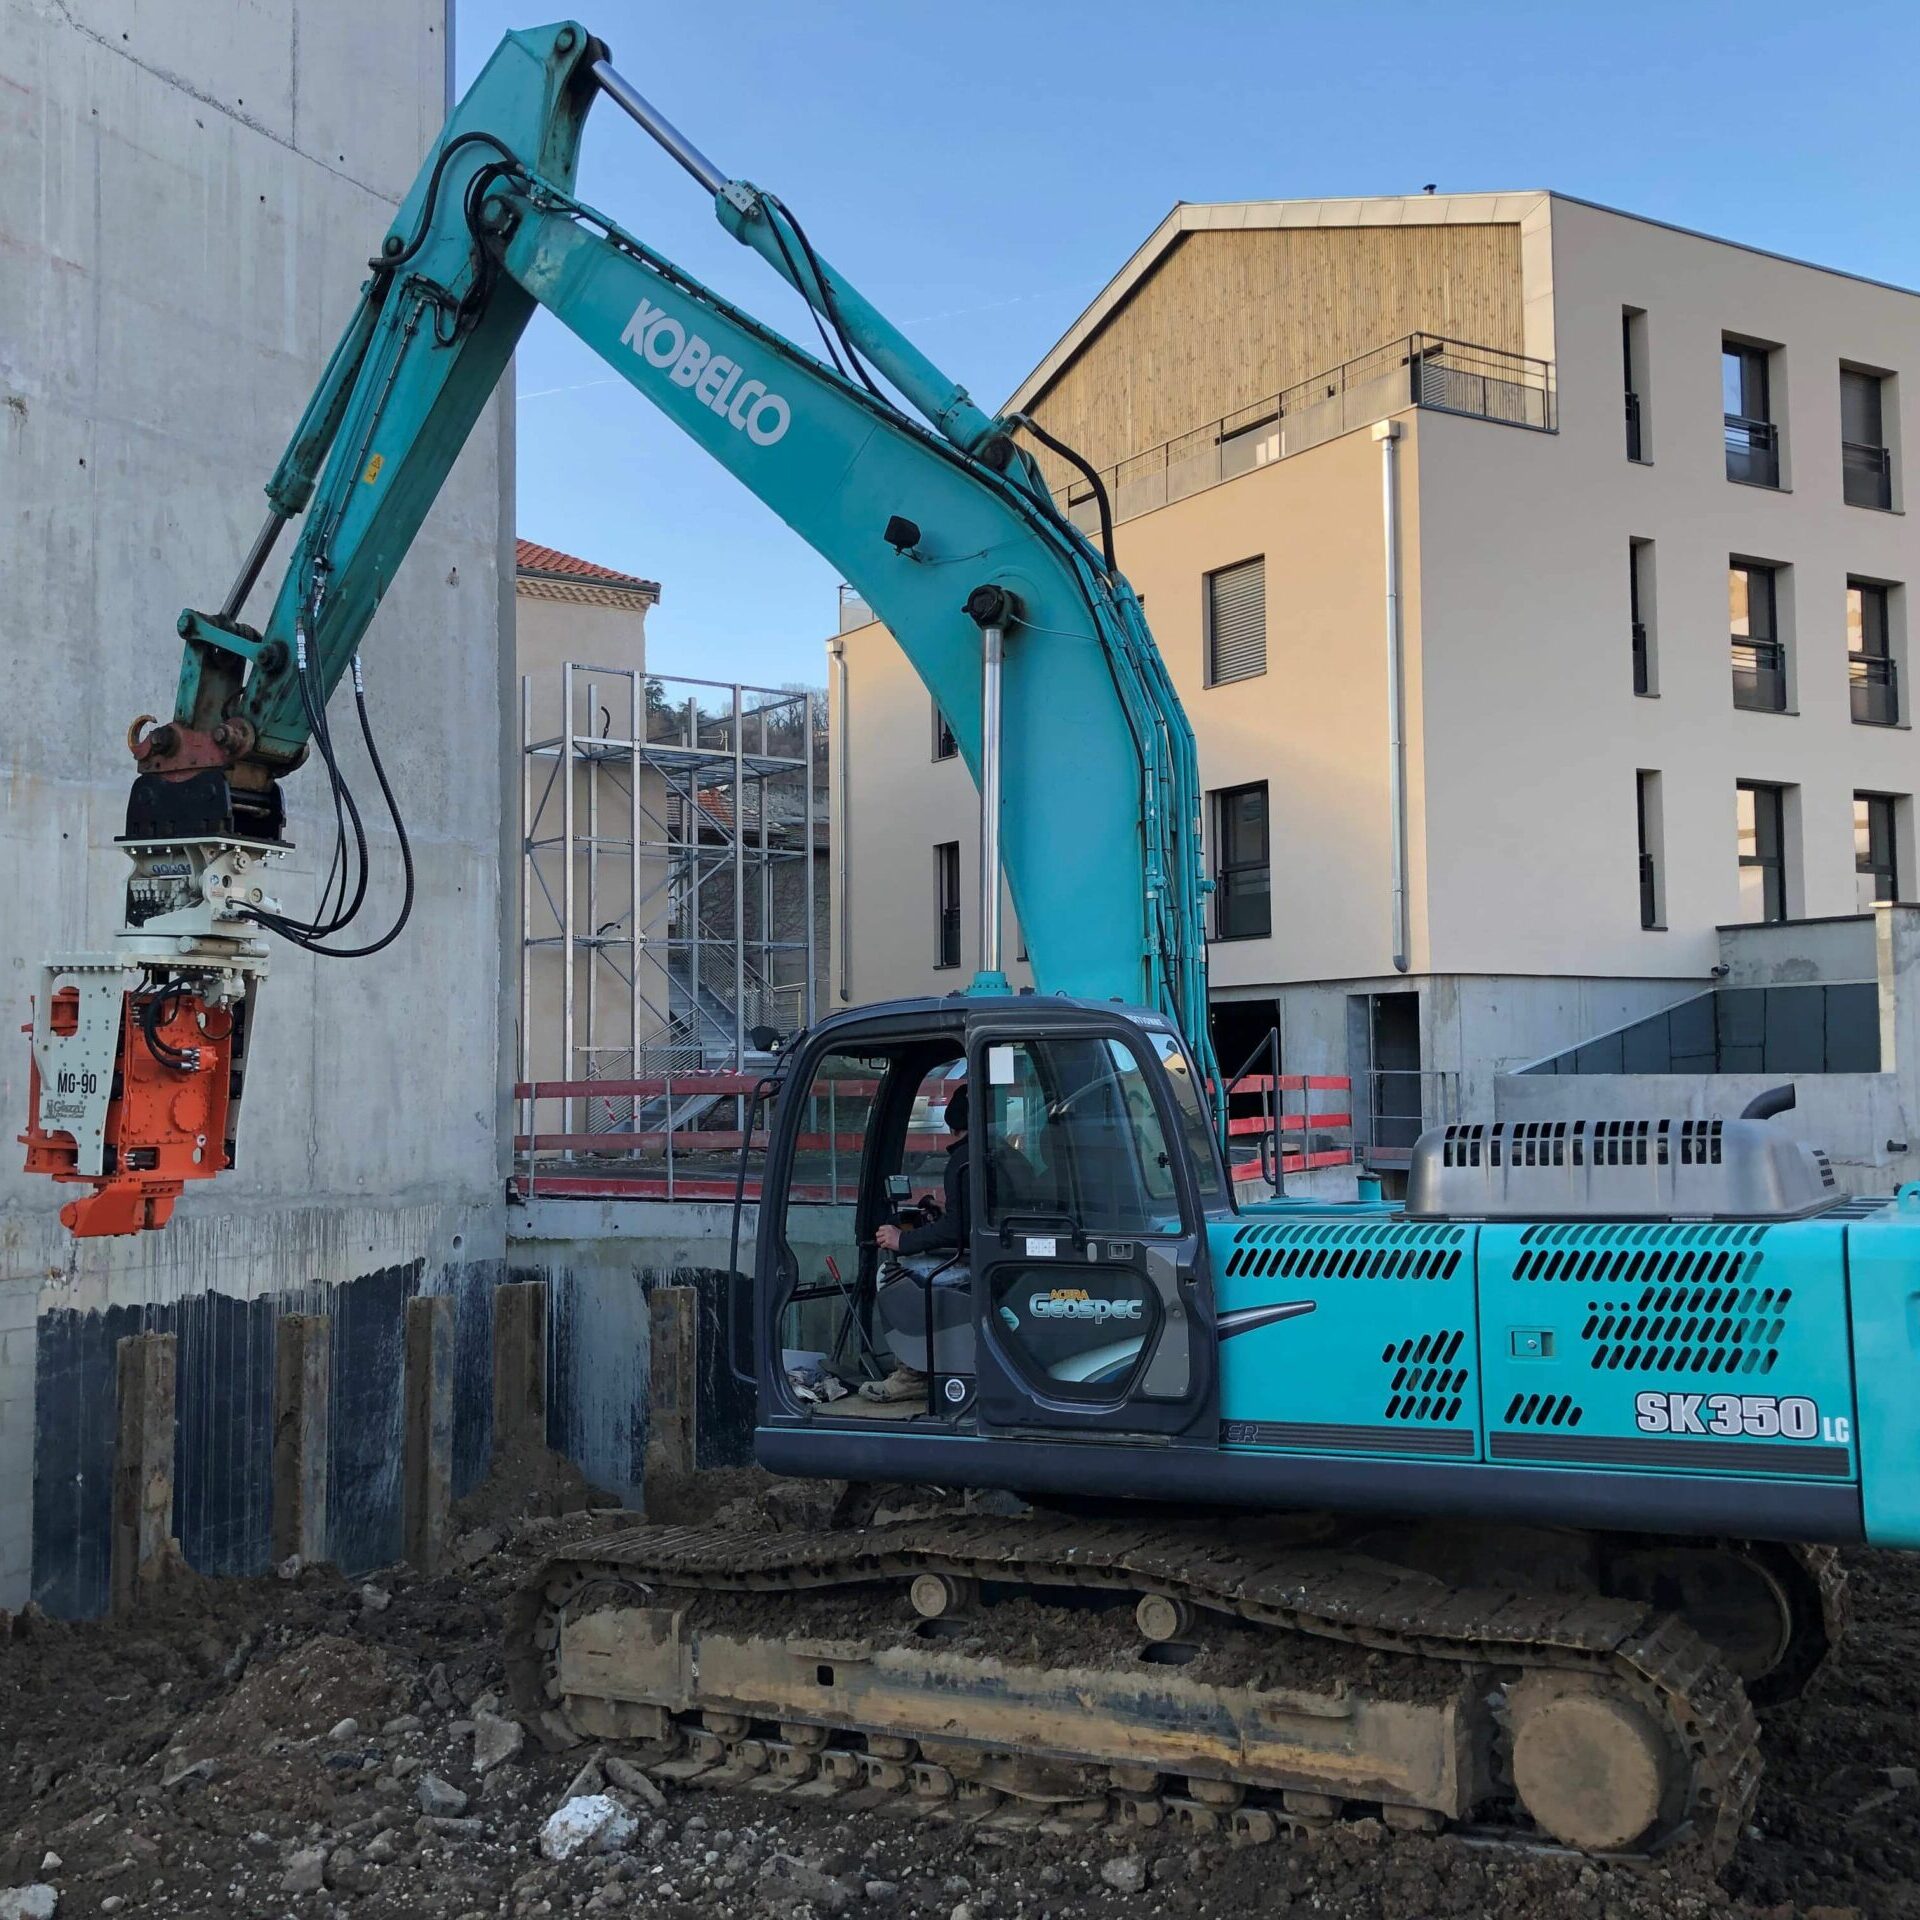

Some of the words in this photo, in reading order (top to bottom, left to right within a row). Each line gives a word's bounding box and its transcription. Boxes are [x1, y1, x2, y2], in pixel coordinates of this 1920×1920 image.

[620, 297, 791, 446] KOBELCO
[57, 1072, 97, 1094] MG-90
[1636, 1391, 1818, 1440] SK350
[1823, 1417, 1850, 1443] LC
